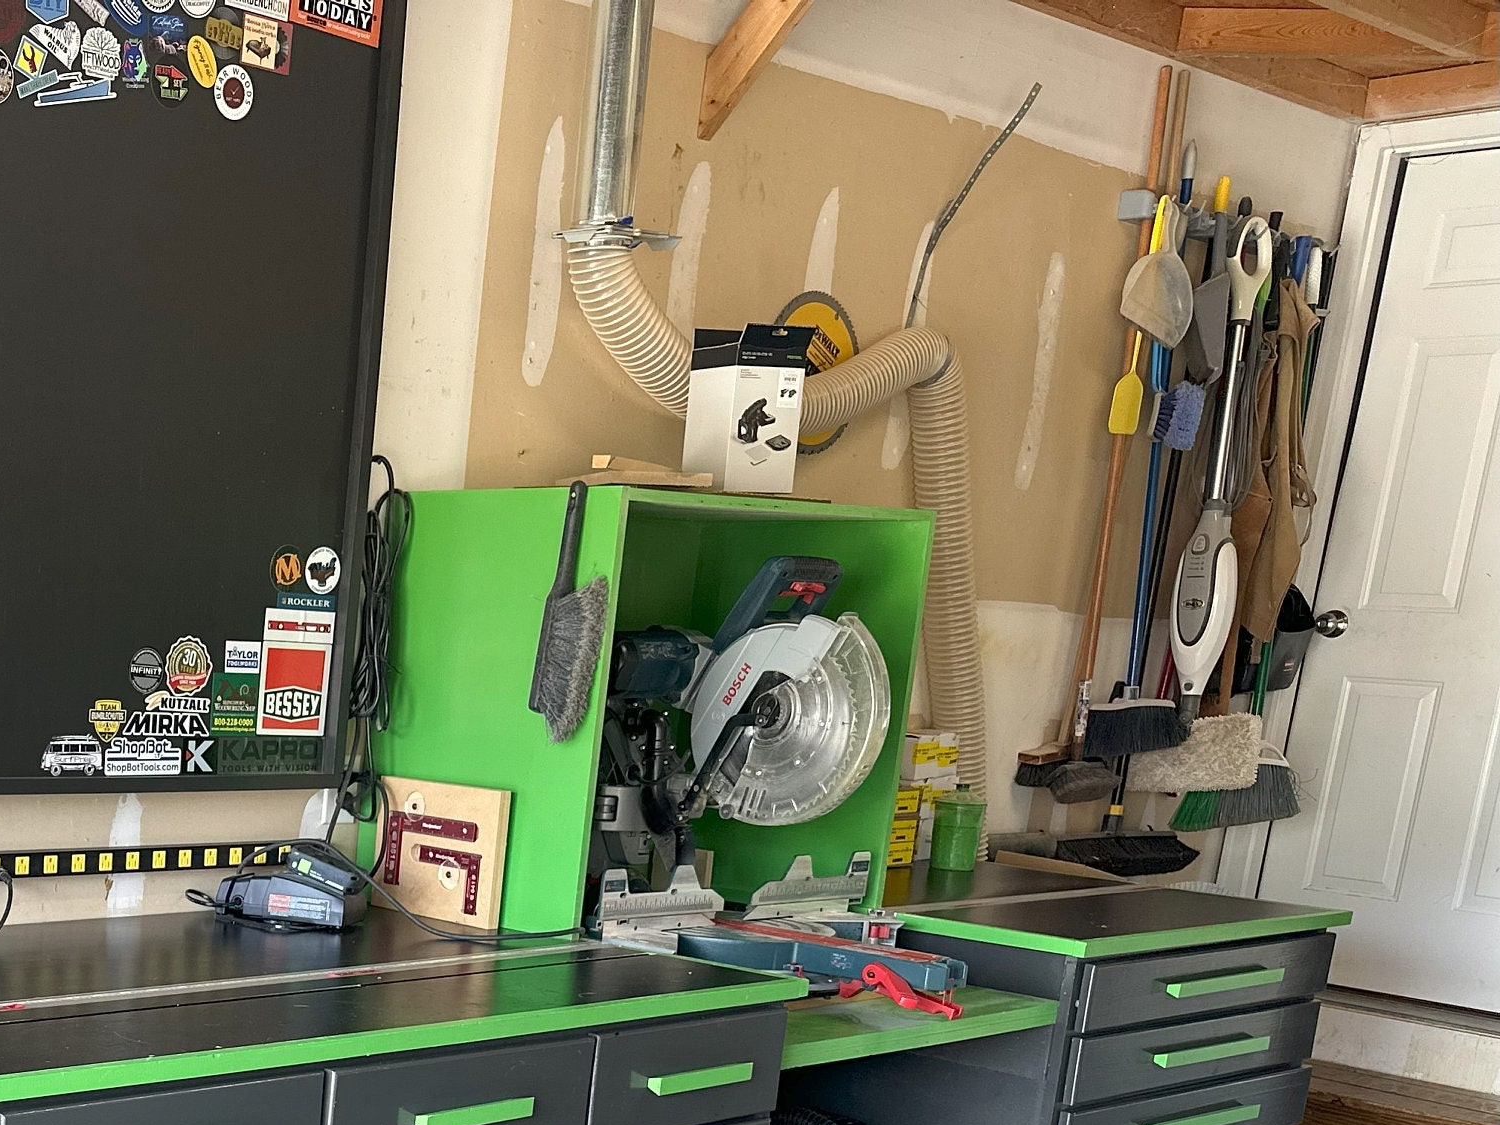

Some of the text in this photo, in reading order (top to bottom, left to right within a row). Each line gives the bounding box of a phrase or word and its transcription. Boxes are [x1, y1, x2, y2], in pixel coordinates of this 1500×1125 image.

[303, 0, 371, 30] TODAY
[44, 27, 68, 54] WALRUS
[47, 41, 58, 54] OIL
[216, 67, 252, 106] BEAR WOODS
[287, 597, 330, 608] ROCKLER
[182, 648, 197, 667] 30
[227, 649, 259, 659] TAYLOR
[131, 666, 162, 676] INFINITY
[722, 662, 752, 706] BOSCH
[100, 703, 117, 711] TEAM
[161, 697, 208, 711] KUTZALL
[265, 690, 320, 718] BESSEY
[124, 713, 209, 734] MIRKA
[112, 739, 170, 754] ShopBot
[221, 740, 319, 760] KAPRO
[186, 740, 215, 773] K
[106, 762, 179, 773] ShopBotTools.com
[222, 763, 318, 773] TOOLS WITH VISION
